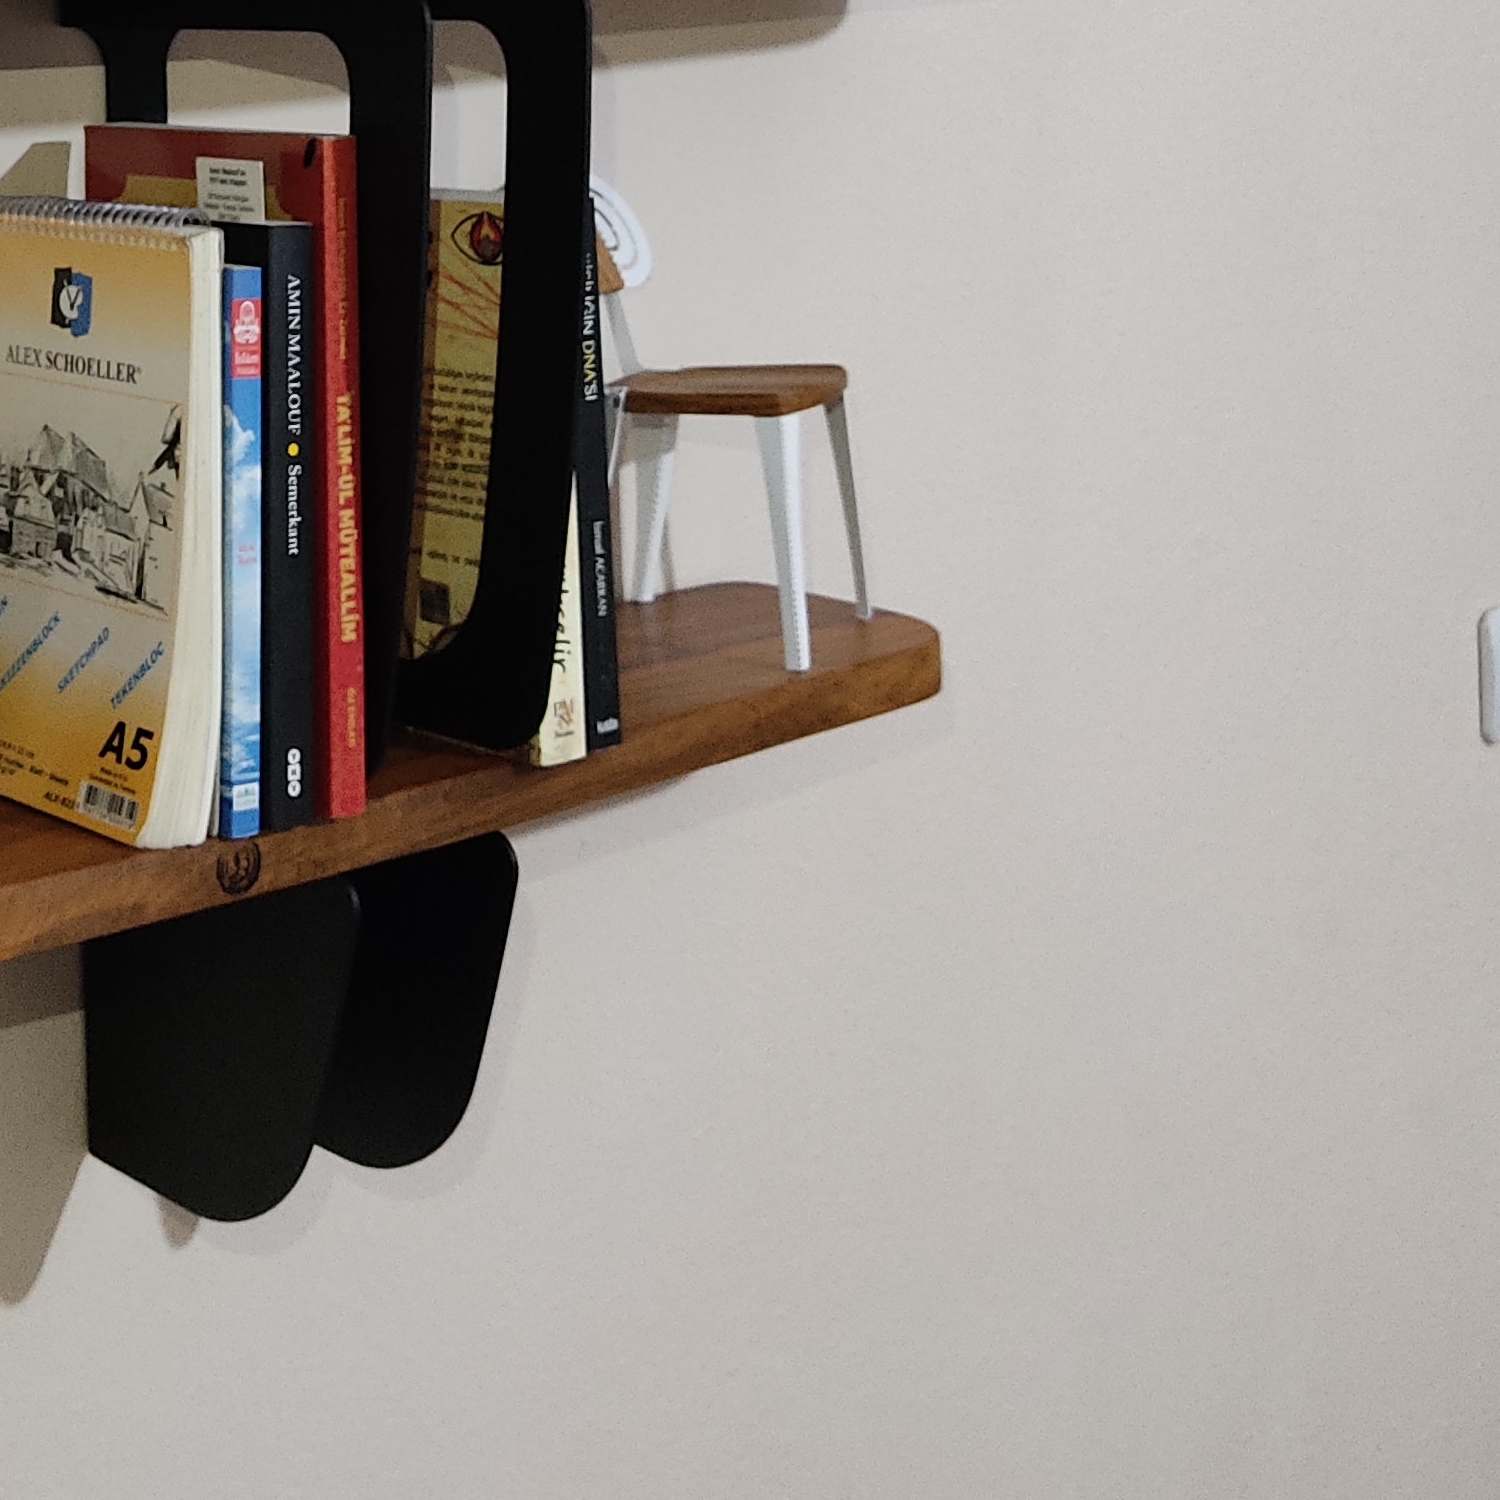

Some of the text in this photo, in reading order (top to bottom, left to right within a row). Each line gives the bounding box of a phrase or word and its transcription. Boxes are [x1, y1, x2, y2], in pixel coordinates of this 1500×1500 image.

[5, 344, 43, 369] ALEX
[287, 274, 302, 556] AMIN MAALOUF Semerkant
[57, 626, 110, 694] SKETCHPAD
[98, 721, 154, 770] A5
